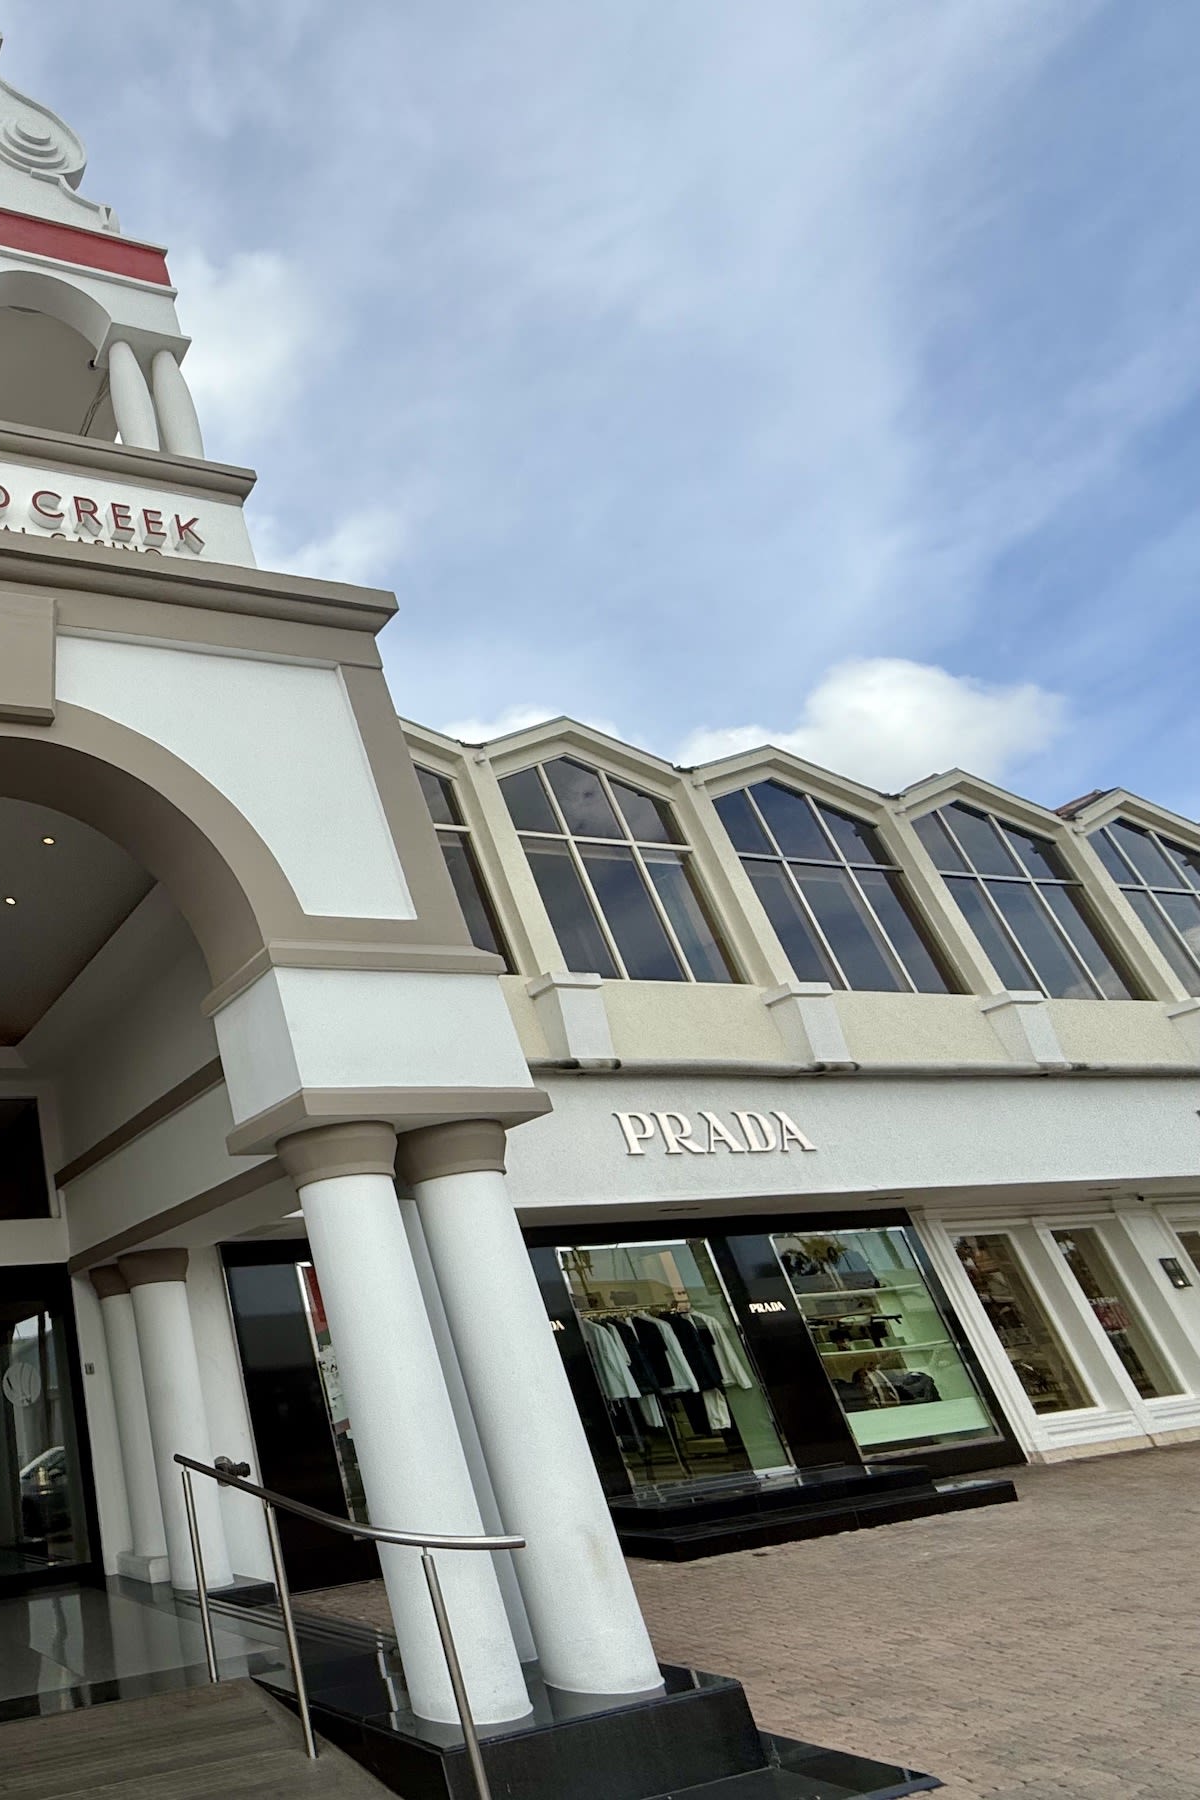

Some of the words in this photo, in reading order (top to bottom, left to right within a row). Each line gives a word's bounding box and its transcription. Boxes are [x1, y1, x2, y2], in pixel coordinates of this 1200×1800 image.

[30, 490, 205, 551] CREEK
[611, 1111, 818, 1156] PRADA
[749, 1300, 787, 1315] PRADA
